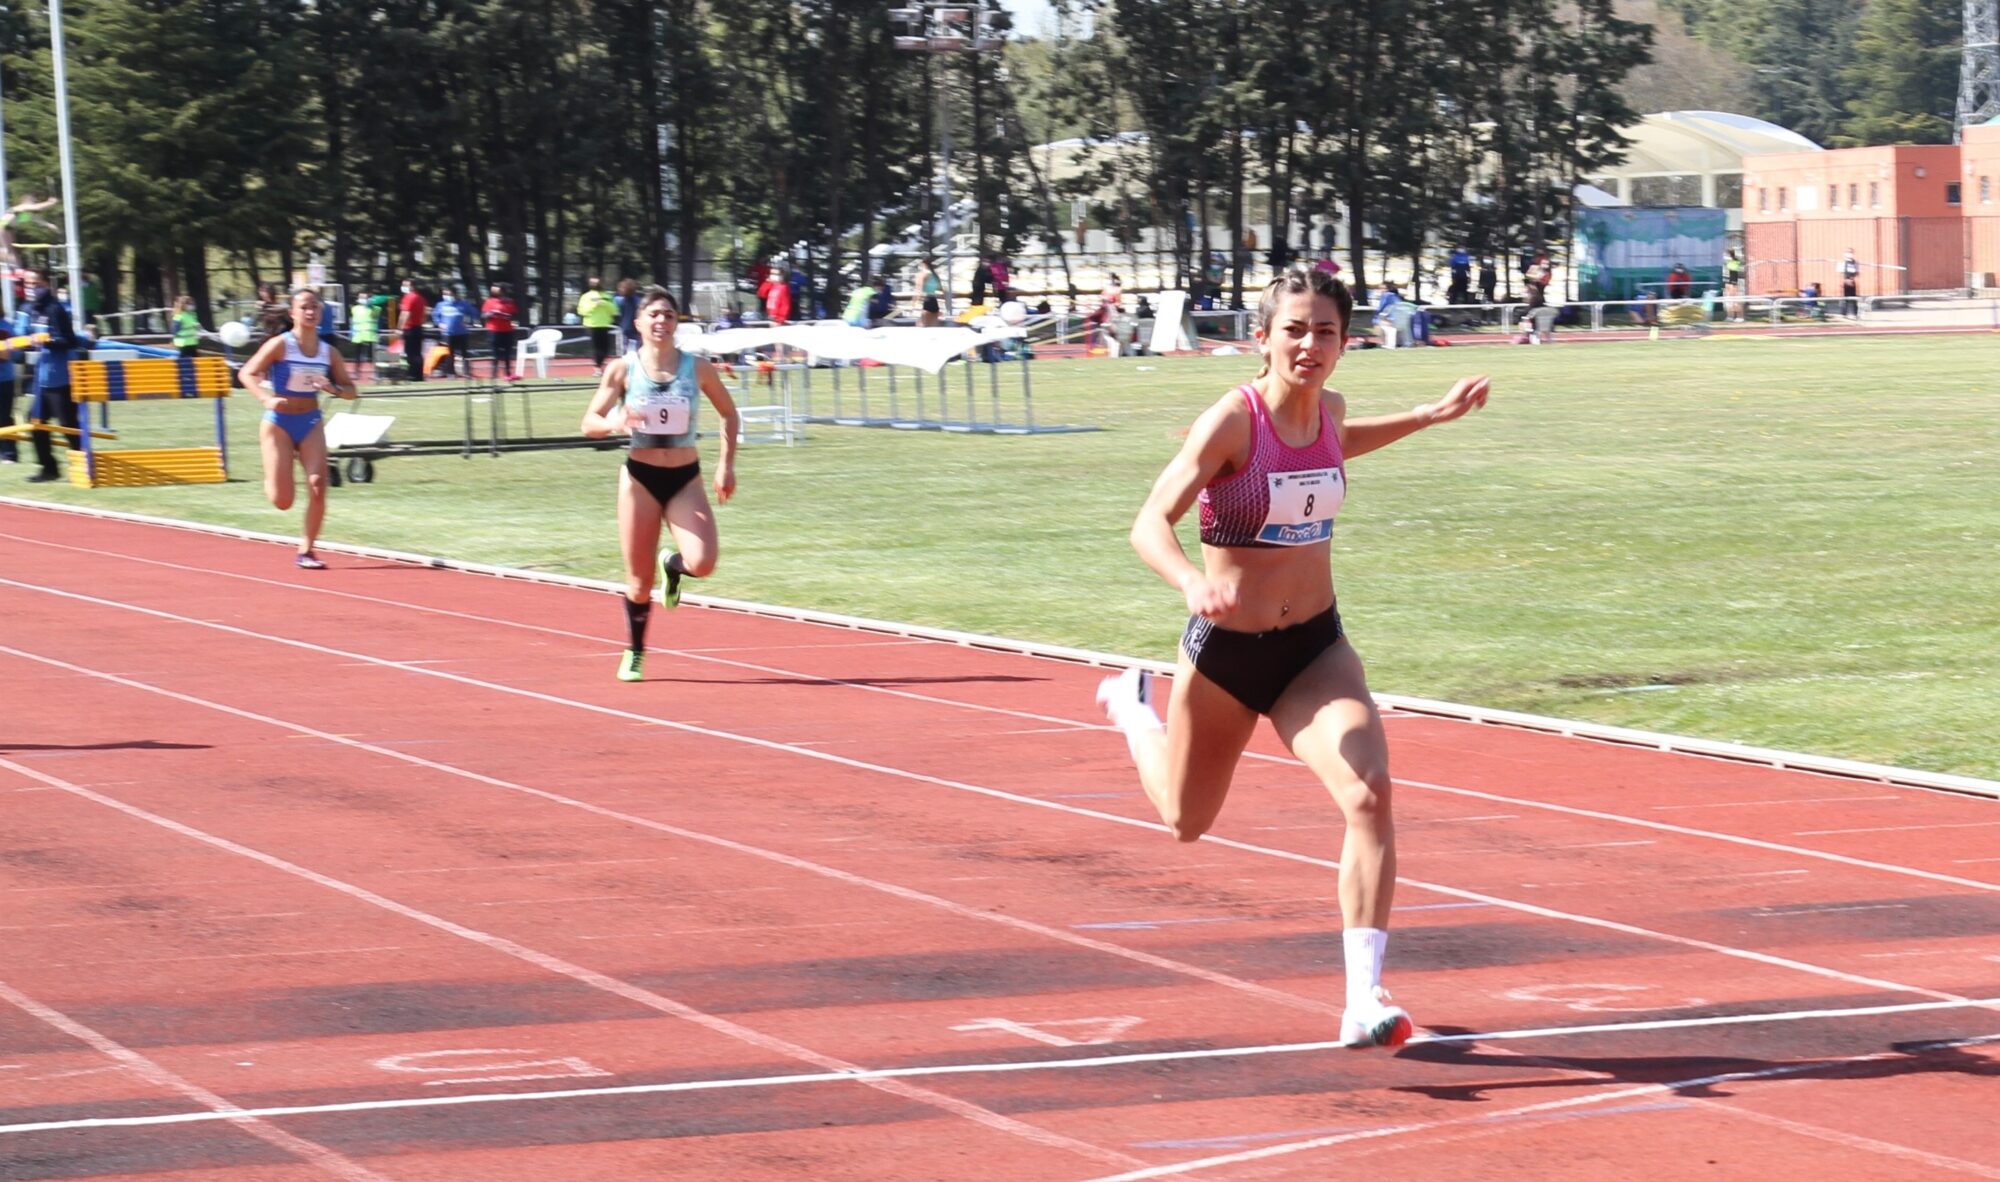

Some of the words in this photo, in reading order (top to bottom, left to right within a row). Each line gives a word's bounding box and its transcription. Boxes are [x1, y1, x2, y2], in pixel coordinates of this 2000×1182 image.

[660, 408, 669, 425] 9
[1303, 493, 1315, 517] 8
[373, 1049, 615, 1086] 5
